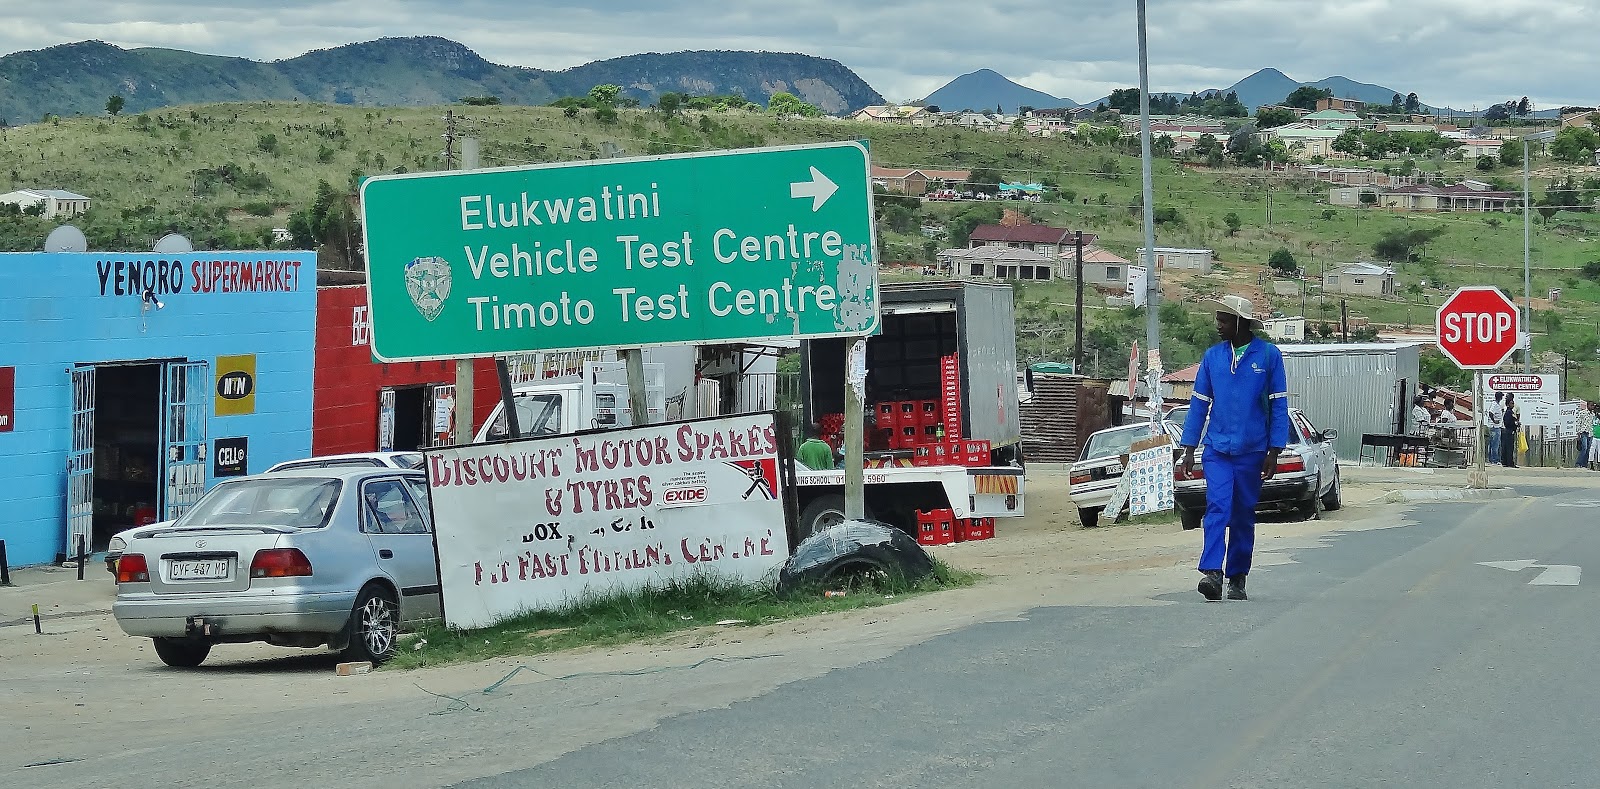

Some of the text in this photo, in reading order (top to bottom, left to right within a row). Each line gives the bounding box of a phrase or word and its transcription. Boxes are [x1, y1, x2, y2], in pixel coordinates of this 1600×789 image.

[460, 183, 660, 232] Elukwatini
[465, 224, 842, 280] Vehicle Test Centre
[190, 260, 302, 293] SUPERMARKET
[467, 277, 837, 332] Timoto Test Centre
[1445, 312, 1512, 343] STOP
[223, 376, 245, 395] MTN
[429, 448, 563, 488] DISCOUNT
[572, 437, 672, 474] MOTOR
[567, 475, 653, 514] TYRES
[665, 489, 705, 501] EXIDE
[809, 475, 831, 485] SCHOOL
[173, 564, 190, 576] CYF
[214, 562, 226, 575] MP
